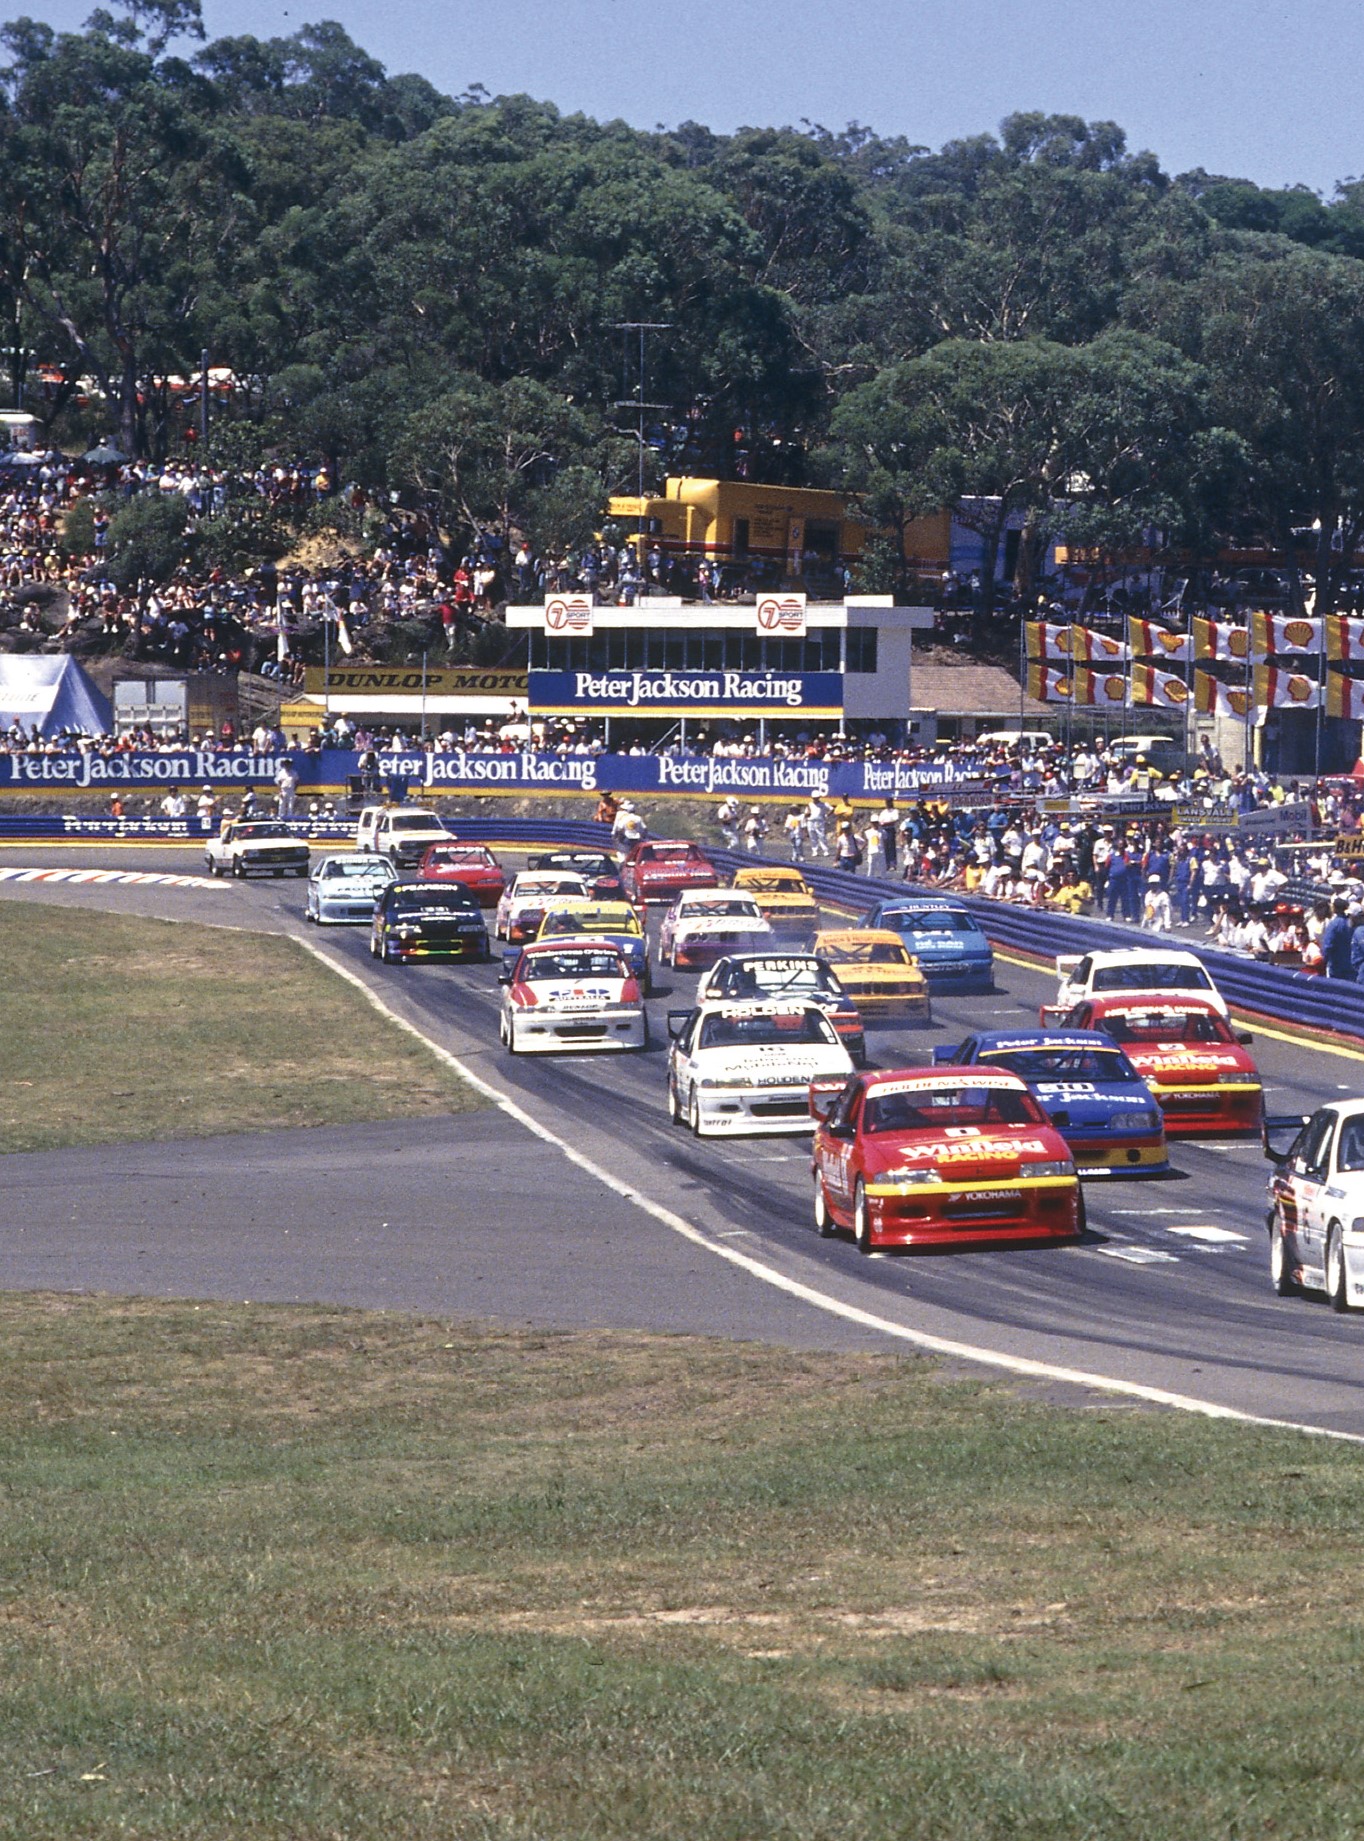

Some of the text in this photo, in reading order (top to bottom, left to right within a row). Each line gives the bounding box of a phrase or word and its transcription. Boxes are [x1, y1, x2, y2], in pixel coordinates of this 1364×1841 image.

[328, 674, 442, 688] DUNLOP
[575, 673, 803, 705] Peter Jackson Racing
[10, 753, 83, 780] Peter
[76, 752, 190, 787] Jackson
[378, 753, 597, 789] eter Jackson Racing
[658, 757, 829, 795] Peter Jackson Racing
[1176, 807, 1233, 817] LANSVALE
[1279, 808, 1307, 822] Mobil
[743, 960, 819, 972] PERKINS
[722, 1006, 805, 1018] HOLDEN
[1129, 1055, 1238, 1068] Winfield
[1153, 1063, 1218, 1072] RACING
[758, 1076, 811, 1085] HOLDEN
[899, 1140, 1047, 1158] Winfield
[936, 1152, 1019, 1163] RACING
[965, 1189, 1022, 1200] YOKOHAMA
